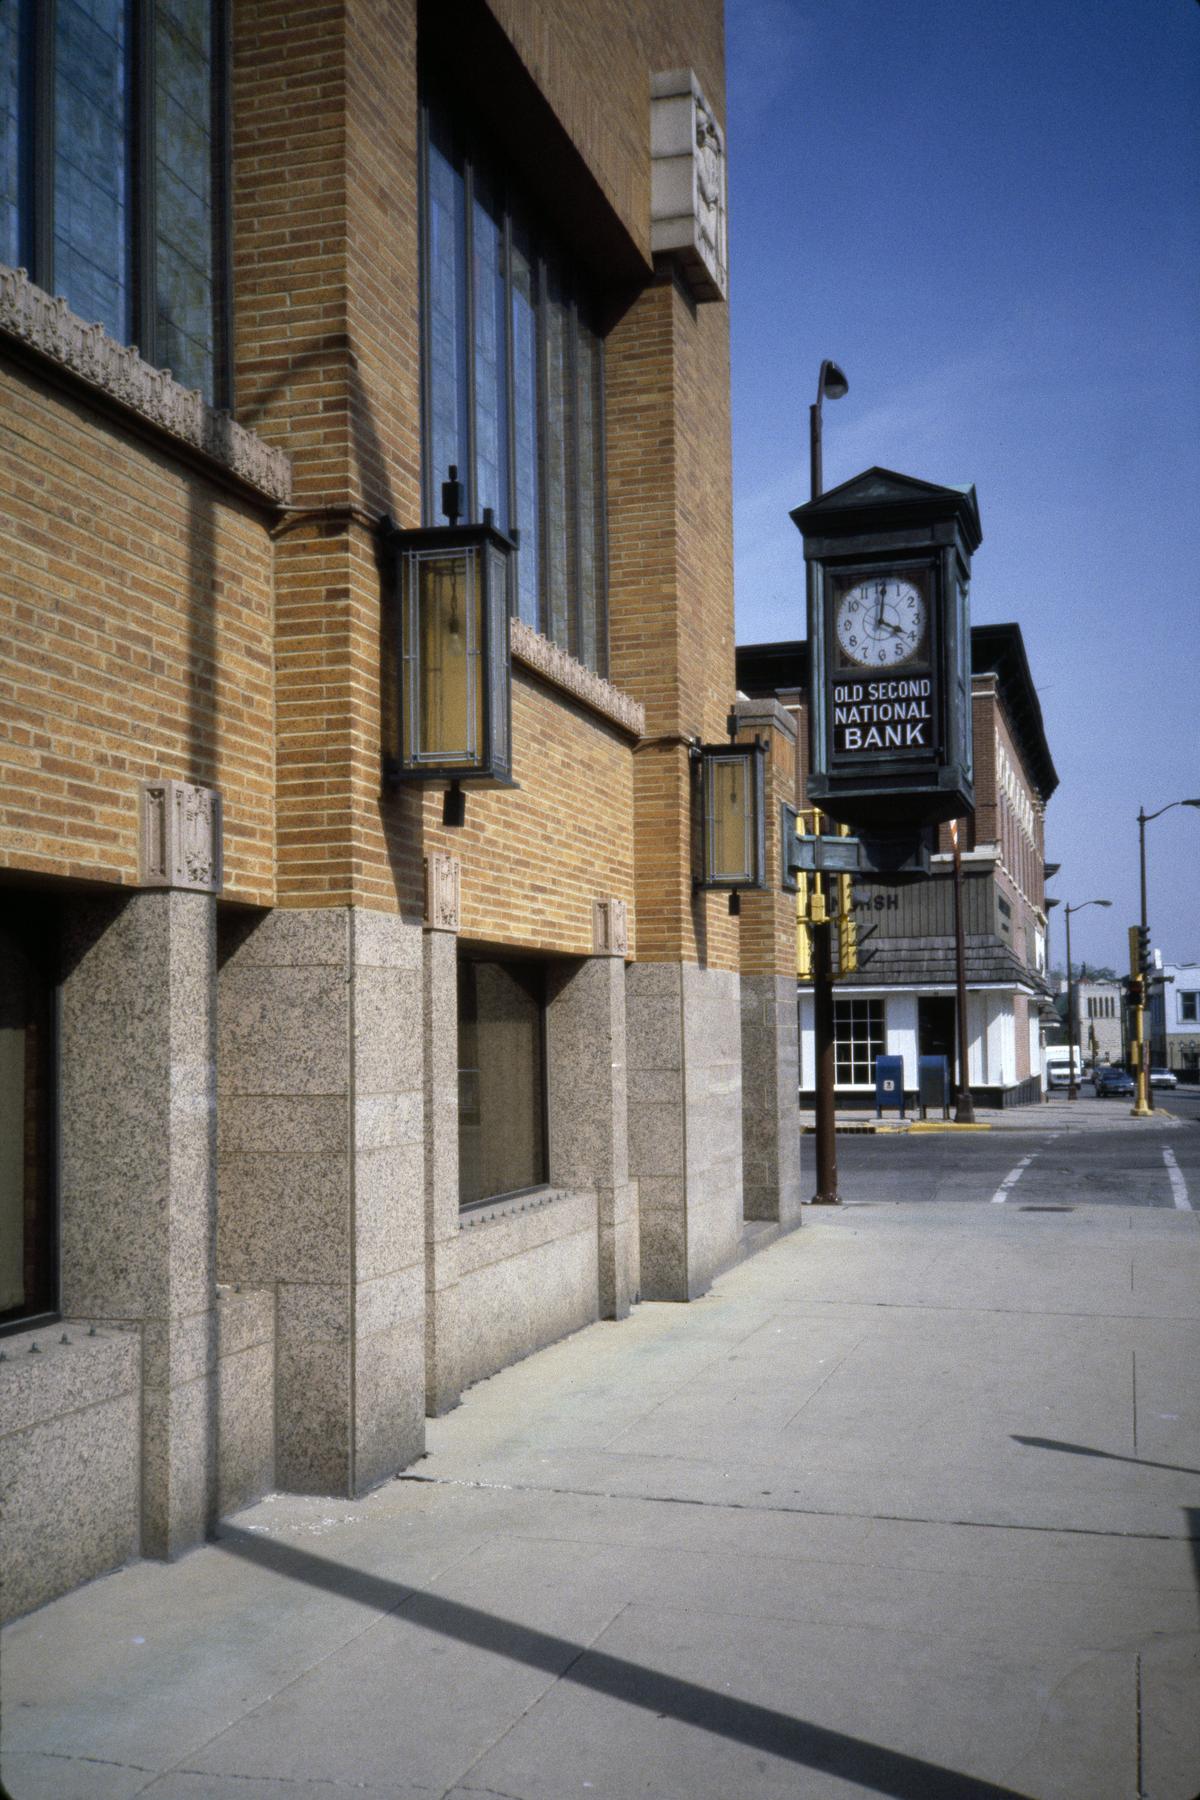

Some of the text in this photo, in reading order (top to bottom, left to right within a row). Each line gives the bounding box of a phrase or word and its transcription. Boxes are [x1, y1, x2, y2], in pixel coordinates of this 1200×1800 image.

[860, 587, 868, 600] 11
[848, 600, 859, 613] 10
[907, 596, 915, 608] 2
[912, 613, 921, 625] 3
[844, 620, 852, 631] 9
[849, 635, 858, 647] 8
[907, 630, 917, 642] 4
[861, 647, 869, 659] 7
[878, 649, 887, 661] 6
[895, 643, 904, 656] 5
[835, 679, 931, 703] OLD SECOND
[835, 701, 932, 725] NATIONAL
[845, 723, 925, 749] BANK
